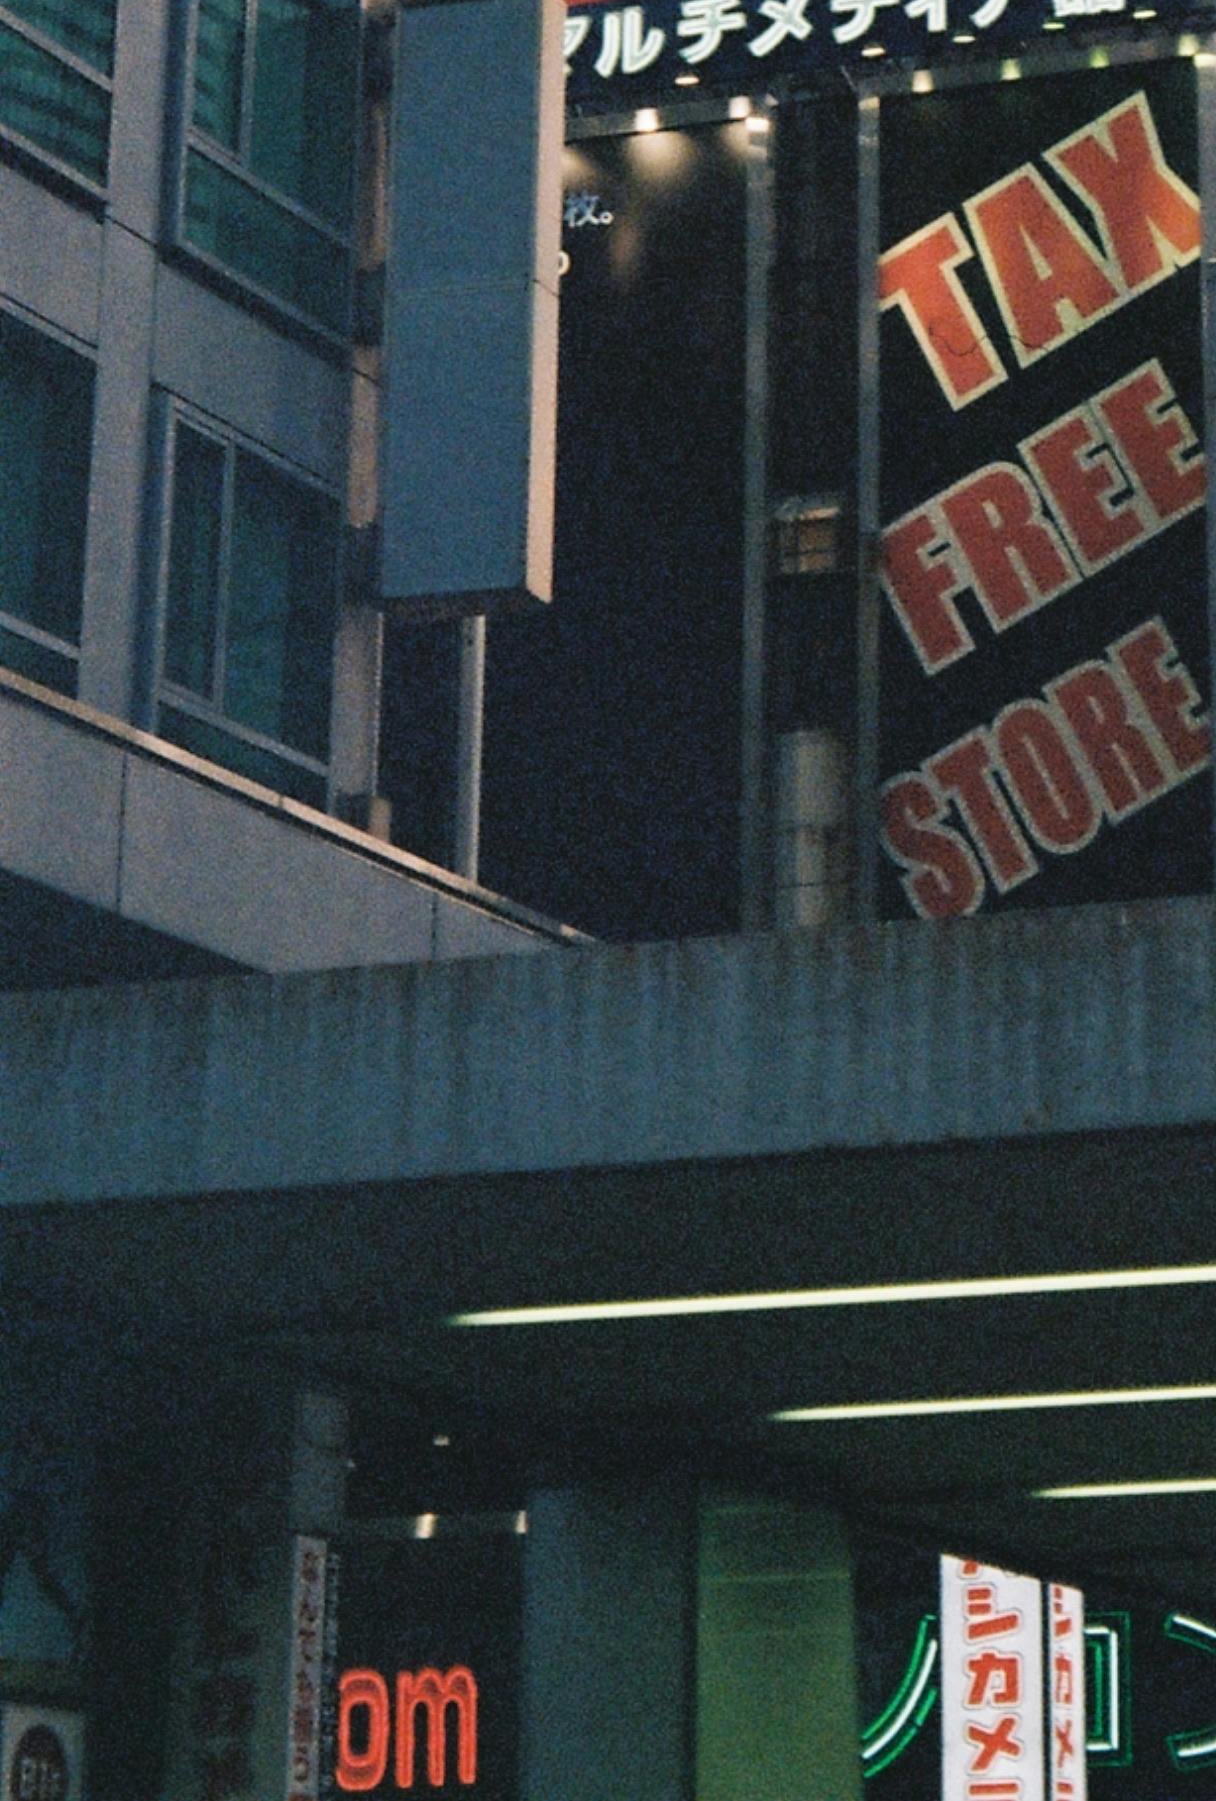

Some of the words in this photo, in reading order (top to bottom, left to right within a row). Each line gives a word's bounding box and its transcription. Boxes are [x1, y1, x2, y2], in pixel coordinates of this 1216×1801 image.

[877, 90, 1202, 412] TAX
[877, 357, 1207, 676] FREE
[879, 615, 1211, 922] STORE
